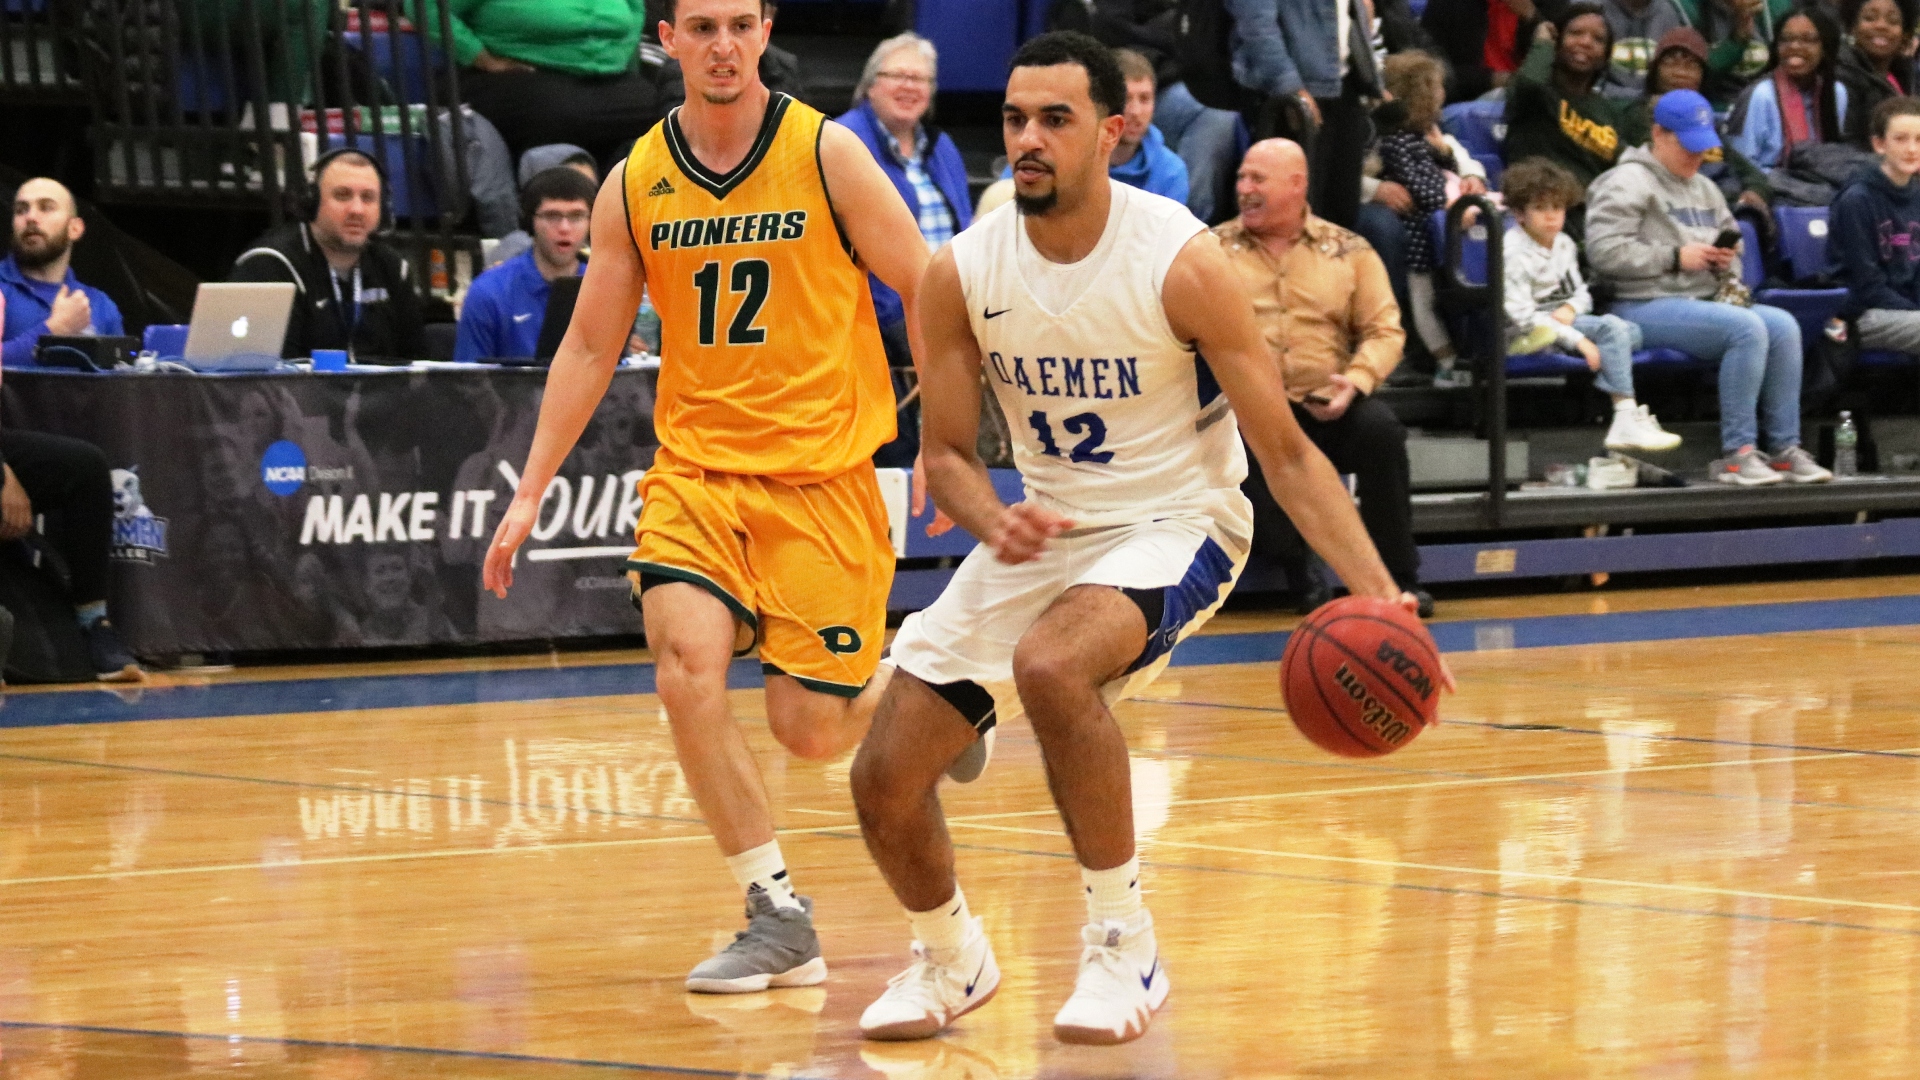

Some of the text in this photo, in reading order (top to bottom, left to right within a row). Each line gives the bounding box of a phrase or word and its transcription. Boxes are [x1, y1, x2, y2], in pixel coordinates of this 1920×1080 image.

[648, 187, 675, 197] adidas
[650, 210, 807, 251] PIONEERS
[693, 257, 771, 347] 12
[989, 351, 1142, 399] DAEMEN
[1028, 410, 1115, 464] 12
[265, 466, 306, 482] NCAA
[300, 492, 439, 545] MAKE
[450, 490, 496, 539] IT
[1377, 639, 1435, 702] NCAA
[1333, 661, 1411, 746] Wilson
